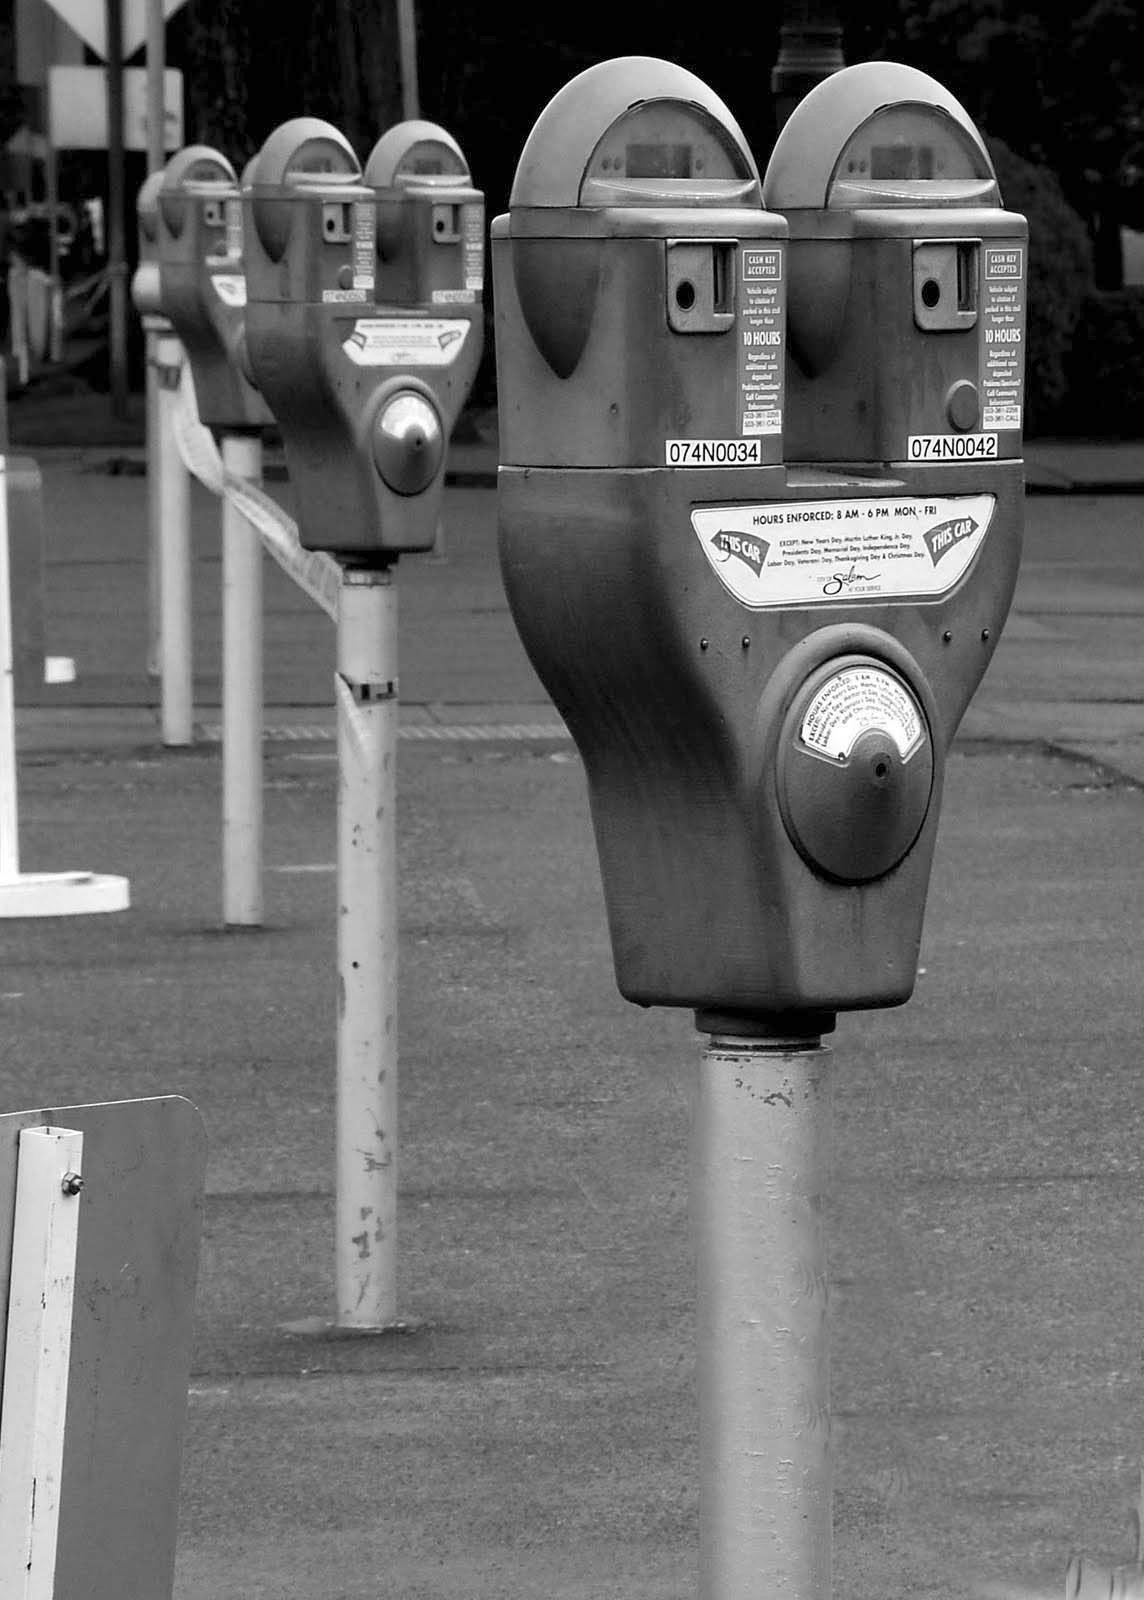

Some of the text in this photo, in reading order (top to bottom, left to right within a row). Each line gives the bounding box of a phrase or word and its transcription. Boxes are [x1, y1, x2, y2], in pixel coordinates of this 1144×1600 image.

[747, 266, 776, 275] ACCEPTED
[990, 264, 1017, 274] ACCEPTED
[744, 331, 781, 346] 10 HOURS
[985, 328, 1021, 343] 10 HOURS
[670, 443, 758, 462] 074N0034
[912, 437, 996, 458] 074N0042
[753, 514, 784, 526] HOURS
[786, 511, 834, 523] ENFORCED:
[836, 510, 842, 520] 8
[845, 509, 860, 518] AM
[868, 508, 874, 518] 6
[876, 508, 889, 517] PM
[894, 506, 917, 516] MON
[924, 506, 937, 515] FRI
[931, 520, 972, 552] THIS CAR
[720, 534, 760, 564] THIS CAR
[822, 565, 881, 596] Salem
